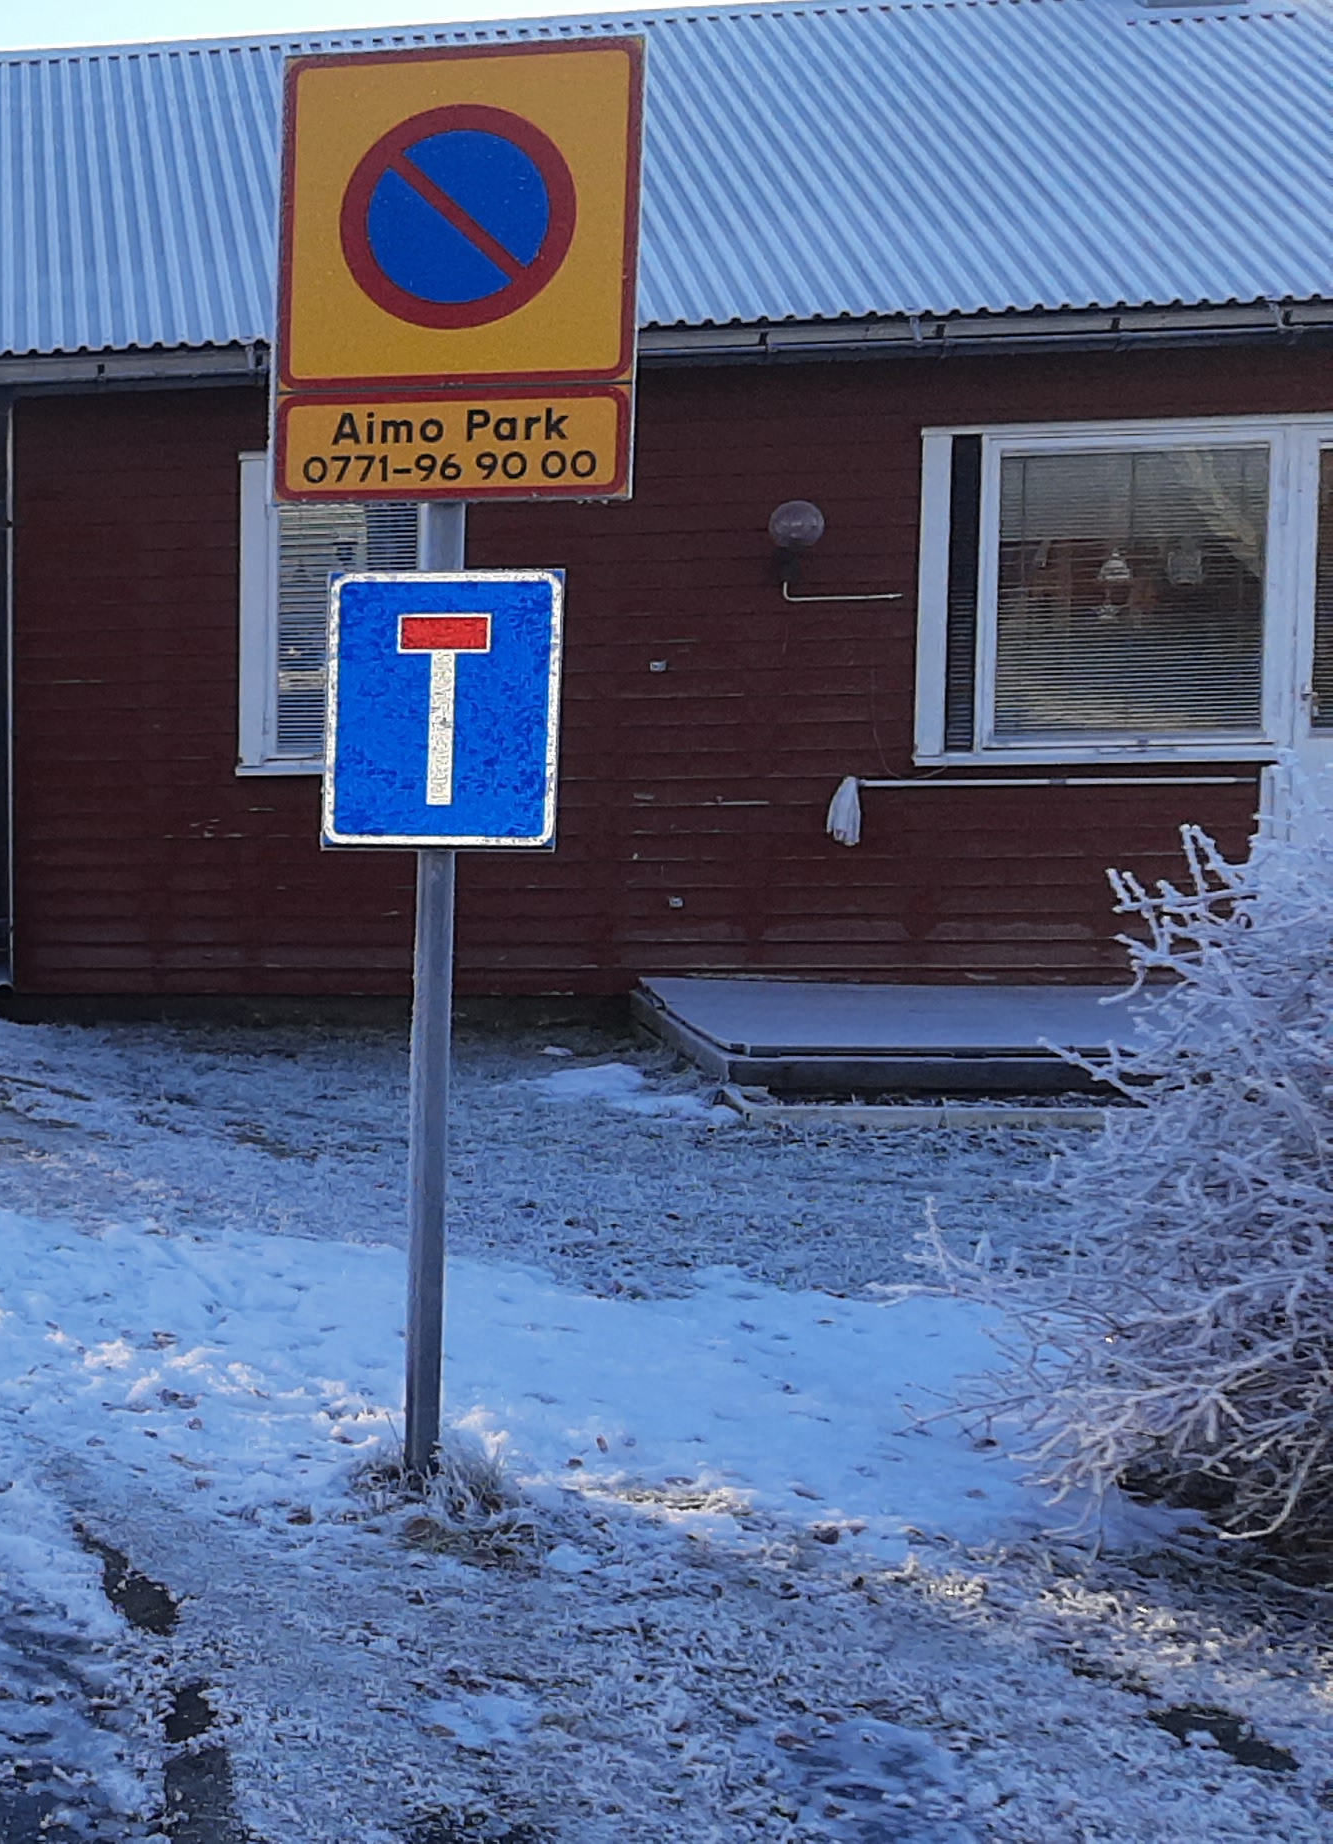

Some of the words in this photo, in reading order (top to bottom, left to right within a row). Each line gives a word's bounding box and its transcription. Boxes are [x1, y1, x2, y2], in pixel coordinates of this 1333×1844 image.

[331, 412, 444, 445] Aimo
[466, 407, 570, 442] Park
[302, 453, 462, 484] 0771-96
[475, 451, 527, 479] 90
[540, 449, 596, 478] 00
